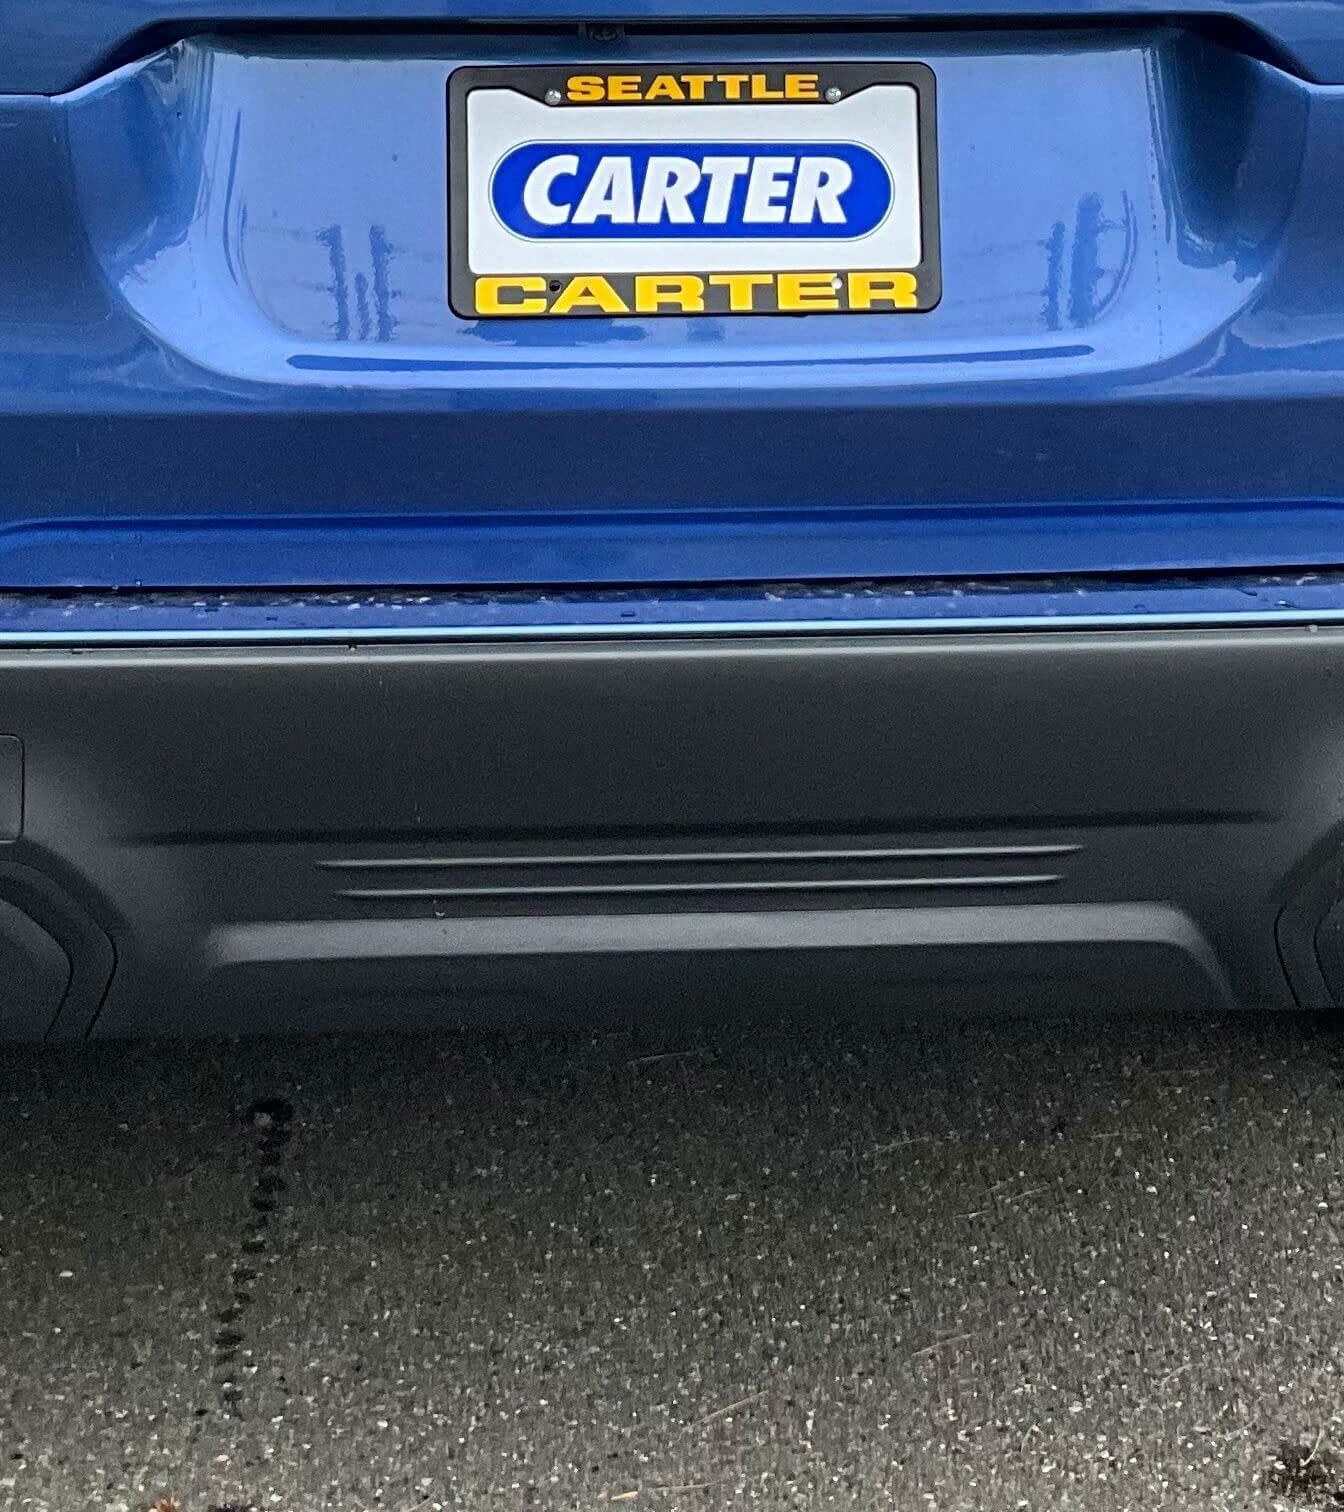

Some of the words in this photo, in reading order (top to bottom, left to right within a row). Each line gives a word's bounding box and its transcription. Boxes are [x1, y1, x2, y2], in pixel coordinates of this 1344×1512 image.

[566, 73, 820, 103] SEATTLE
[522, 153, 853, 226] CARTER
[473, 271, 918, 315] CARTER
